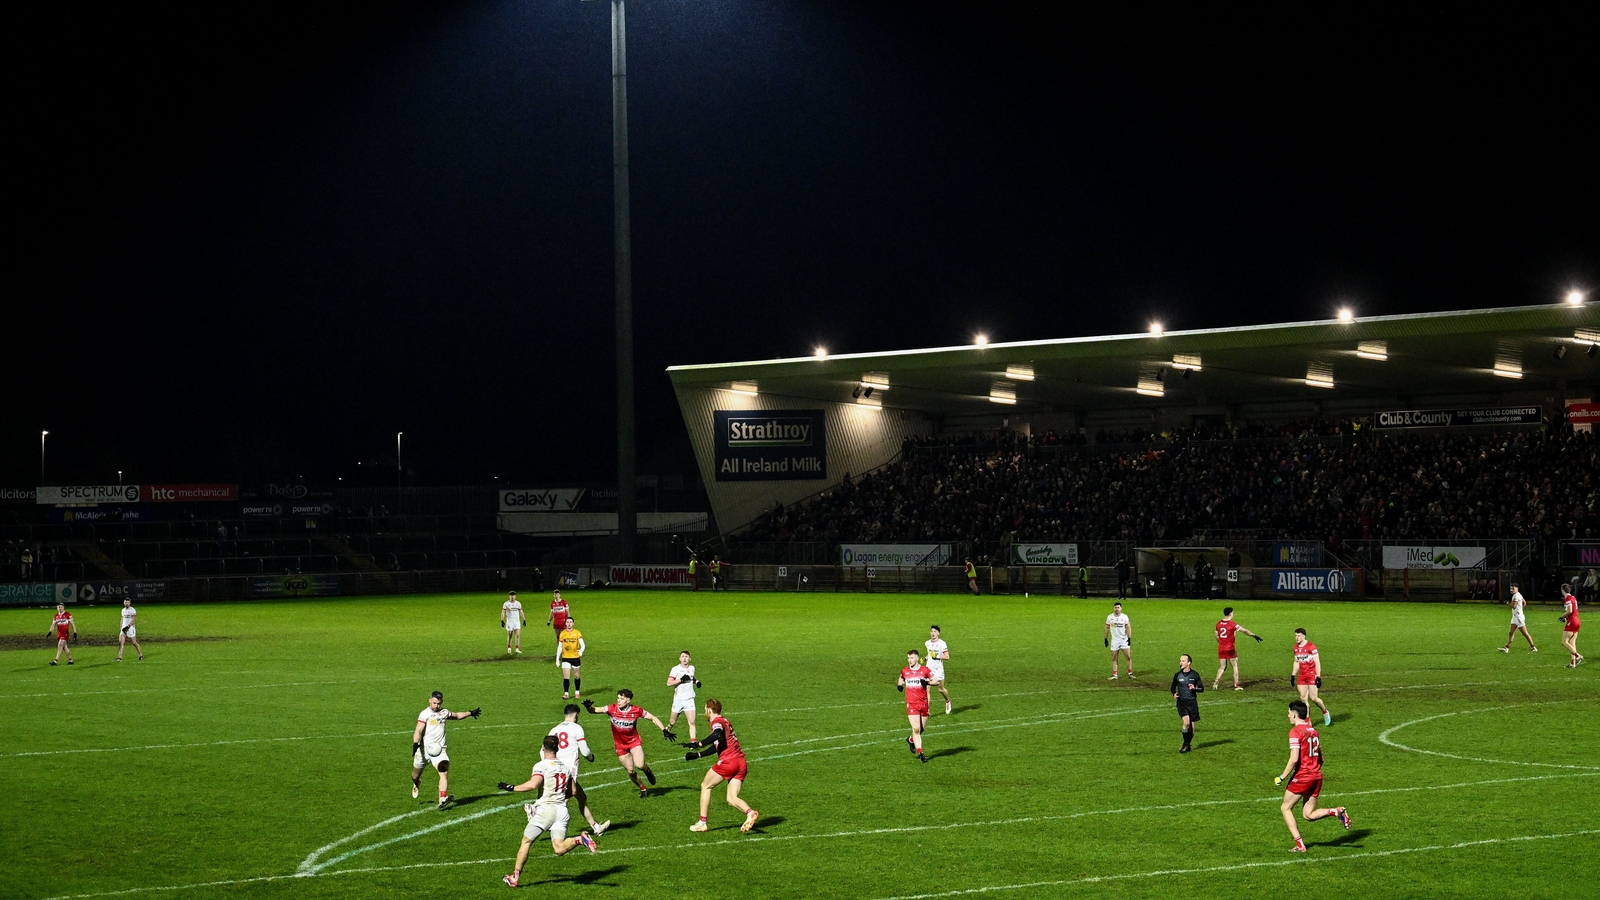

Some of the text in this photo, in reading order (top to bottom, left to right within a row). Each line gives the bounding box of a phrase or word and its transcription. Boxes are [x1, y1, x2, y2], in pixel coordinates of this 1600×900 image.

[731, 421, 809, 441] Strathroy
[721, 457, 821, 473] All Ireland Milk
[0, 489, 36, 499] licitors
[61, 486, 122, 498] SPECTRUM
[151, 487, 175, 500] htc
[178, 487, 229, 497] mechanical
[504, 490, 558, 509] Galaxy
[854, 551, 877, 564] Lagan
[878, 553, 904, 564] energy
[1407, 548, 1434, 561] iMed
[612, 568, 641, 582] OMAGH
[779, 567, 786, 575] 13
[1228, 571, 1237, 580] 45
[1277, 571, 1325, 590] Allianz
[99, 584, 129, 595] Abac
[1220, 627, 1228, 639] 2
[1307, 736, 1320, 757] 12
